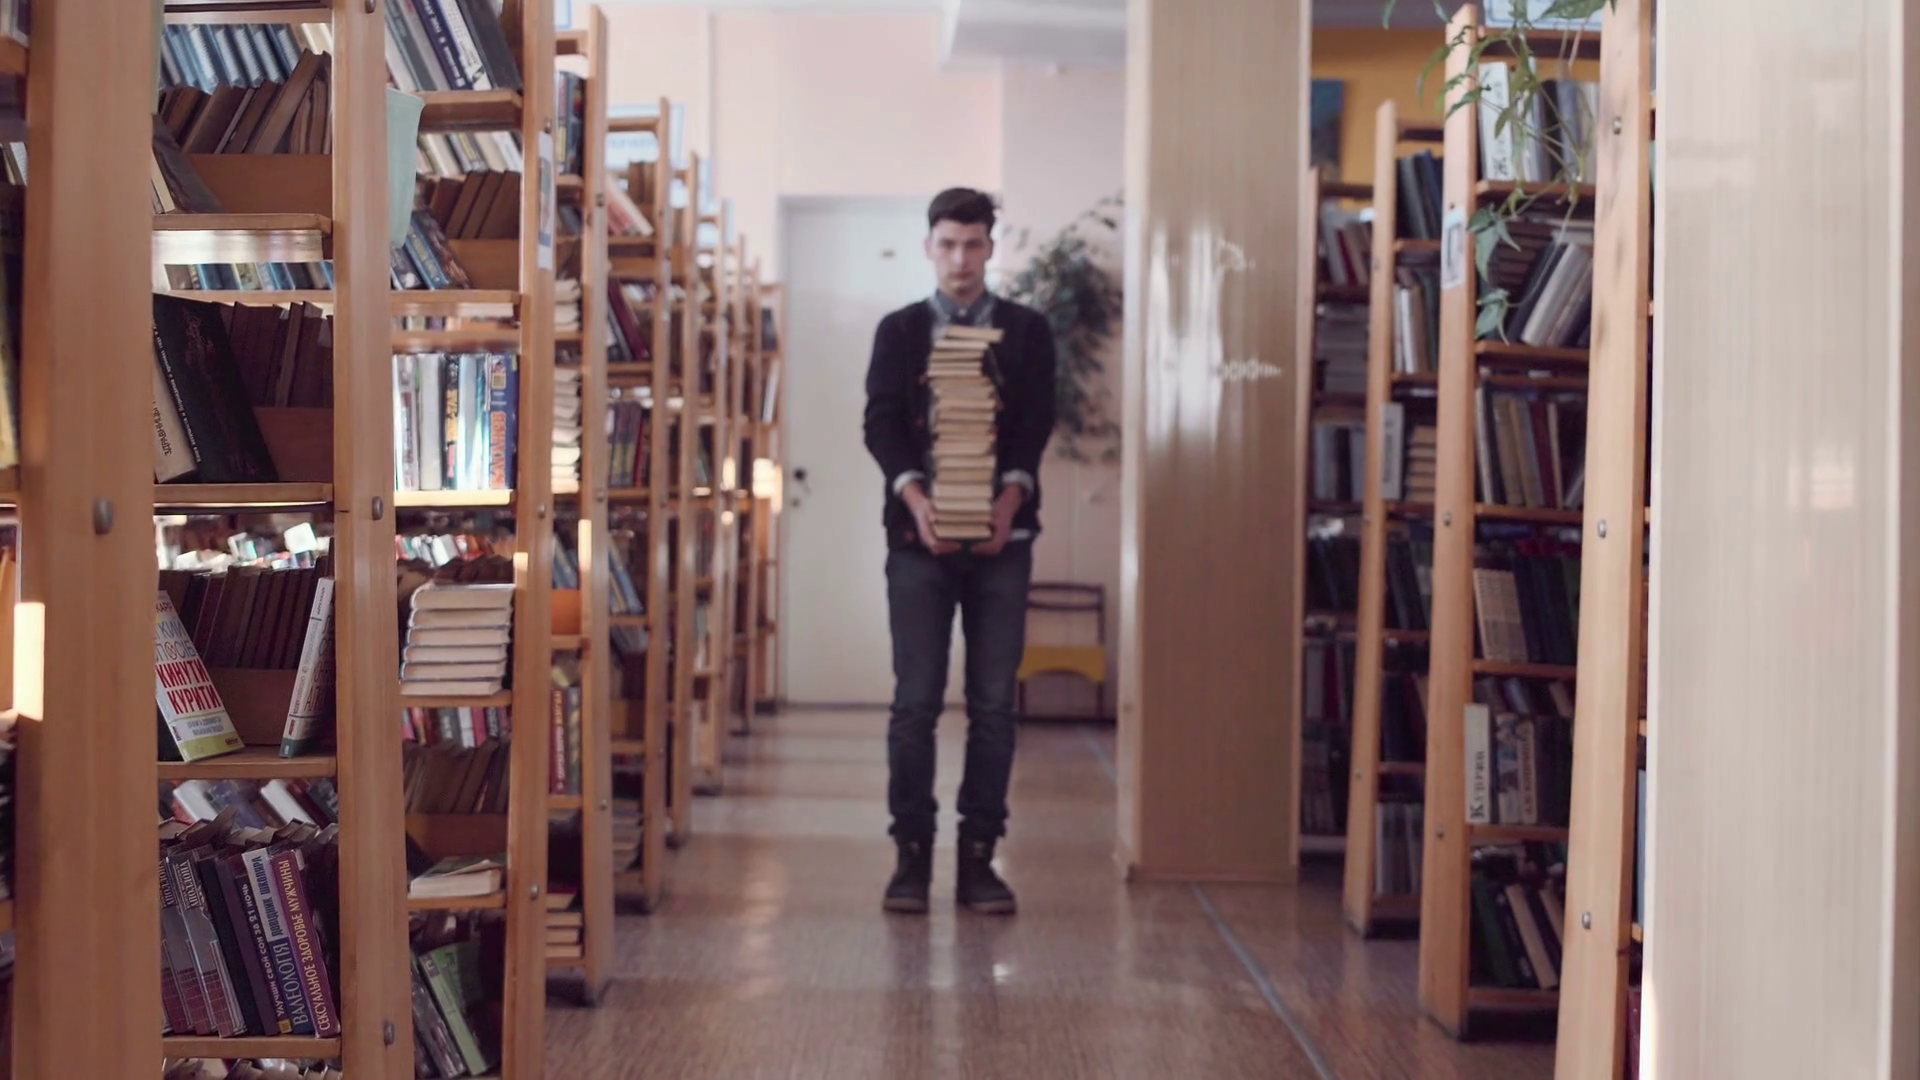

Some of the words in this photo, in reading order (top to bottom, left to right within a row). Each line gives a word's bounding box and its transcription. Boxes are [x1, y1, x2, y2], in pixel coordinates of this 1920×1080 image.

[155, 640, 196, 662] ПОСІБ
[155, 659, 210, 689] КИНУТИ
[167, 684, 221, 715] КУРИТИ
[252, 856, 271, 895] ШКОЛЯРА
[278, 859, 301, 912] МУЖЧИНЫ
[241, 883, 254, 907] ночь
[248, 910, 258, 922] 21
[253, 923, 262, 935] за
[262, 896, 284, 937] ДОВІДНИК
[256, 937, 267, 954] сон
[291, 913, 314, 963] ЗДОРОВЬЕ
[261, 956, 274, 979] свой
[270, 981, 285, 1018] Улучши
[273, 942, 309, 1026] ВАЛЕОЛОГІЯ
[304, 963, 331, 1031] СЕКСУАЛЬНОЕ
